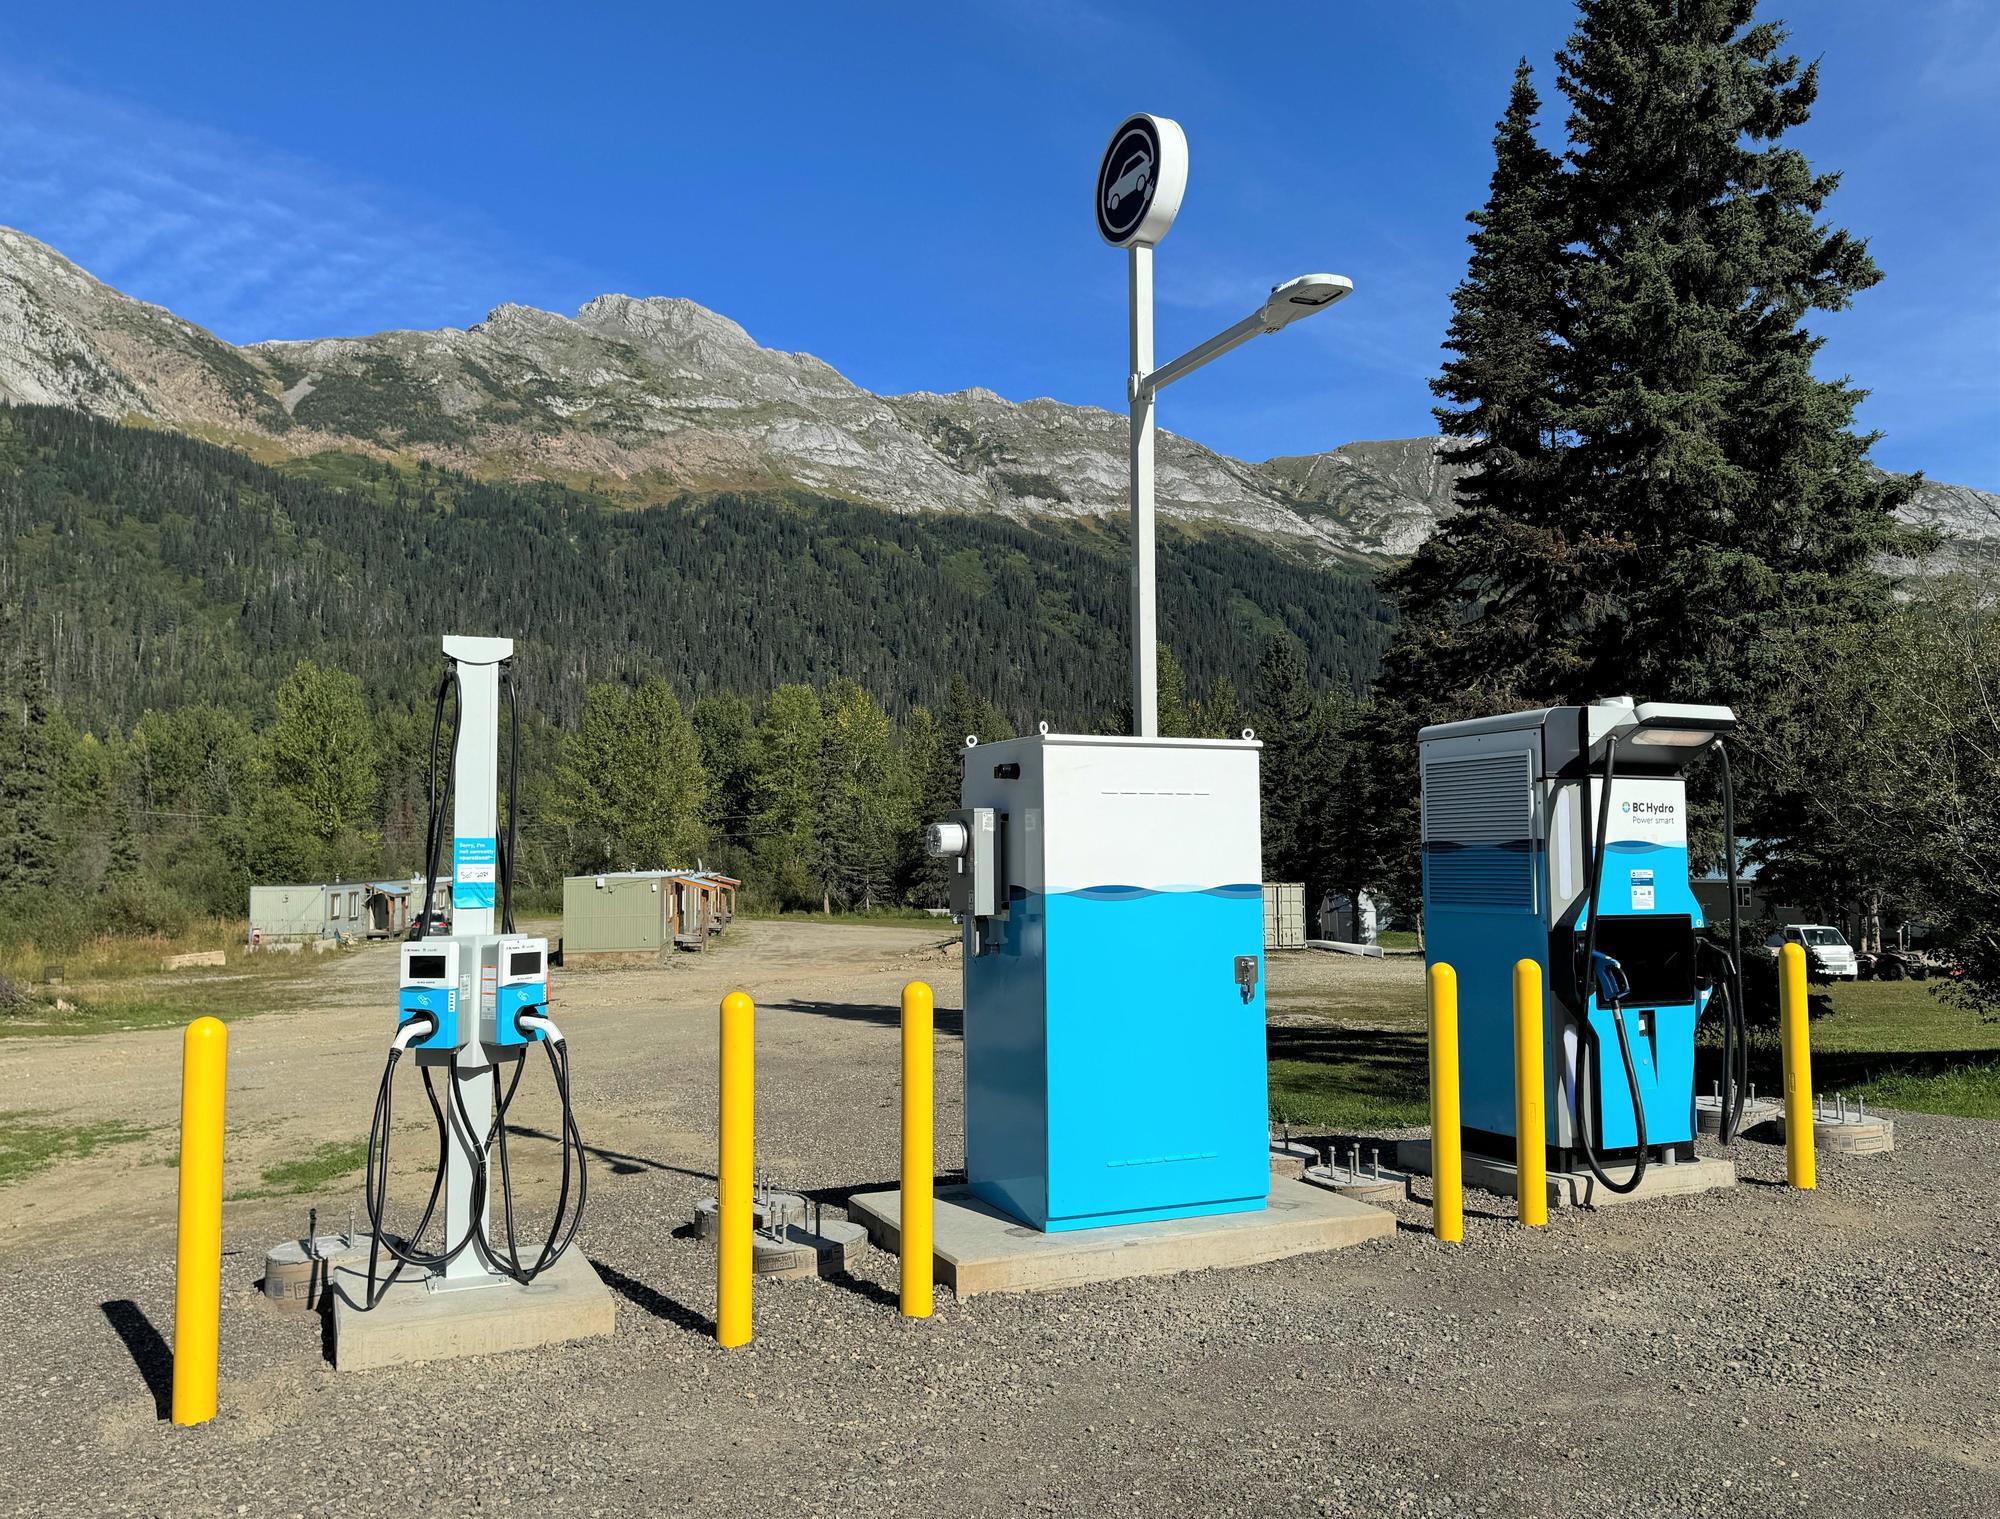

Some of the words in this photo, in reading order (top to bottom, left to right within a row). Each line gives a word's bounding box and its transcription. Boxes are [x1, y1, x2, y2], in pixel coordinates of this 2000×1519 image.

[1632, 802, 1645, 812] BC
[1646, 802, 1674, 815] Hydro
[1632, 816, 1653, 824] Power
